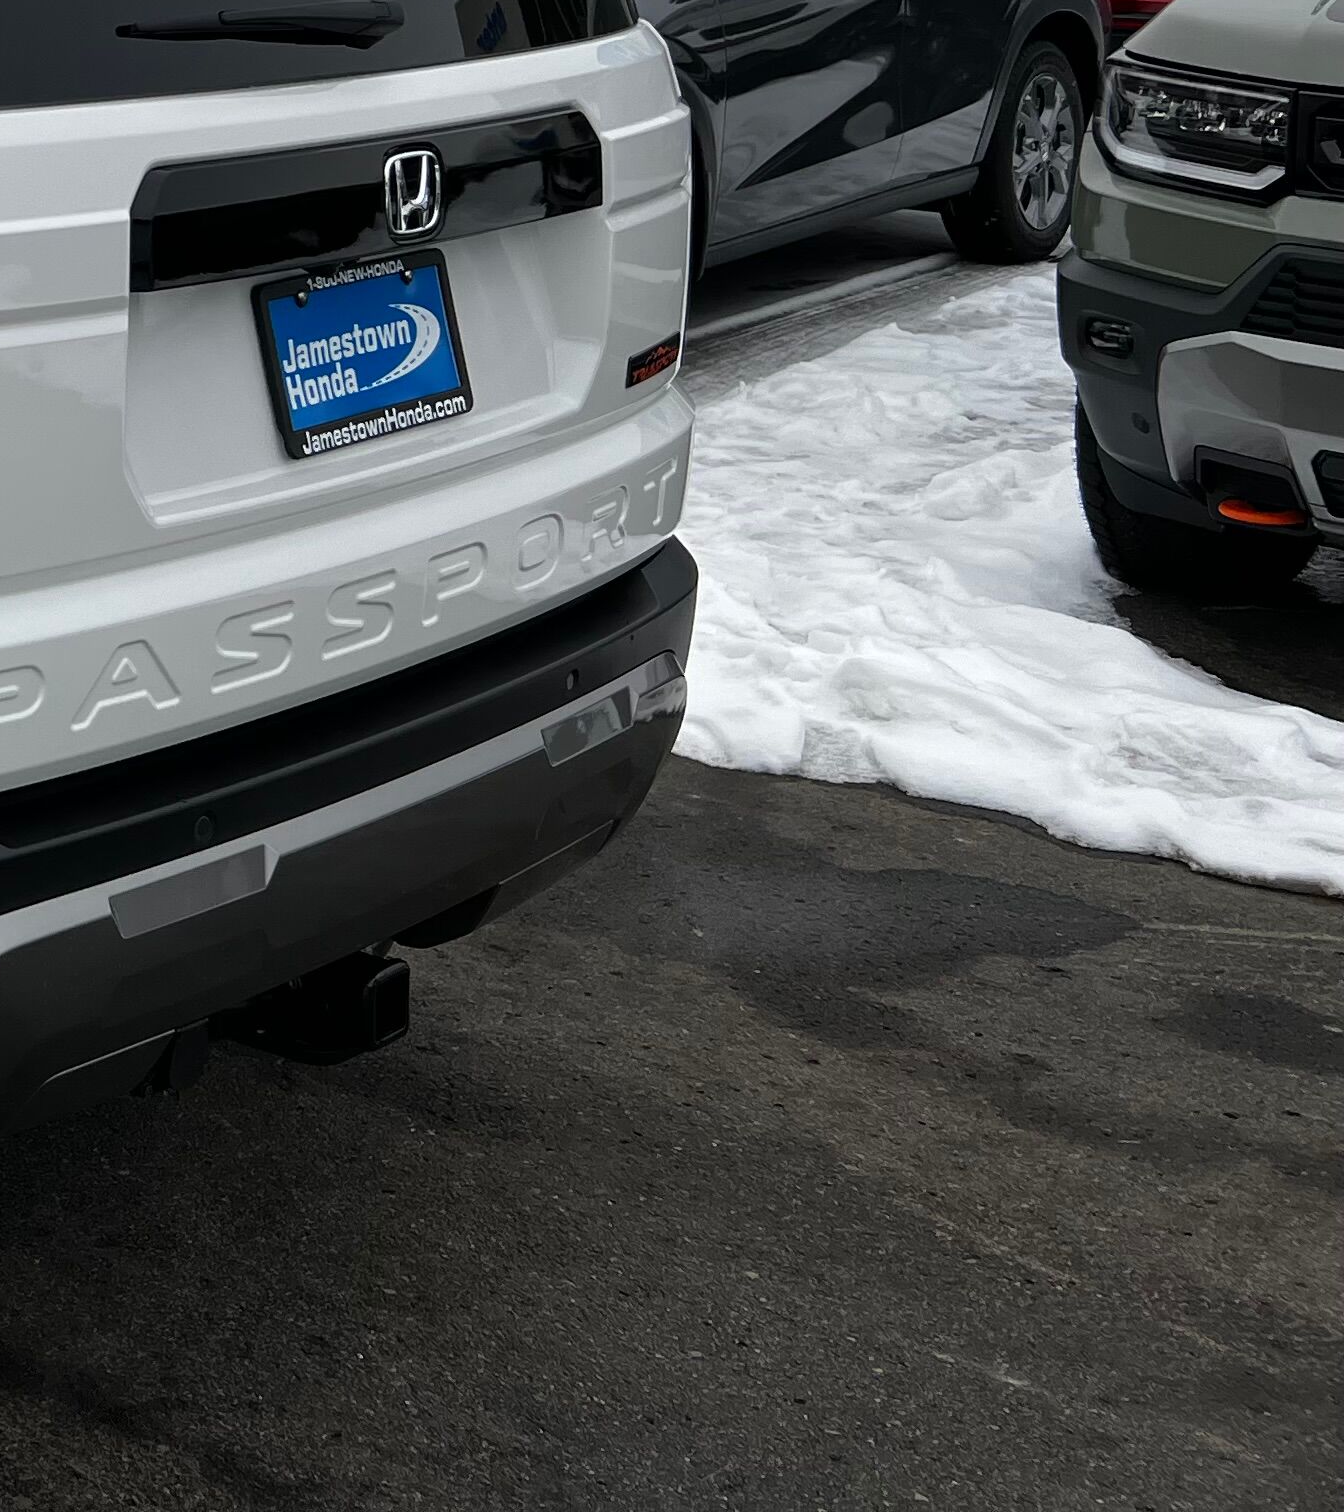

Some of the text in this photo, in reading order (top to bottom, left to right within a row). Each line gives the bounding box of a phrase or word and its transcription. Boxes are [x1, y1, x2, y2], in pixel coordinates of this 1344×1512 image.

[282, 319, 412, 374] Jamestown
[285, 363, 359, 410] Honda
[302, 395, 467, 455] JamestownHonda.com
